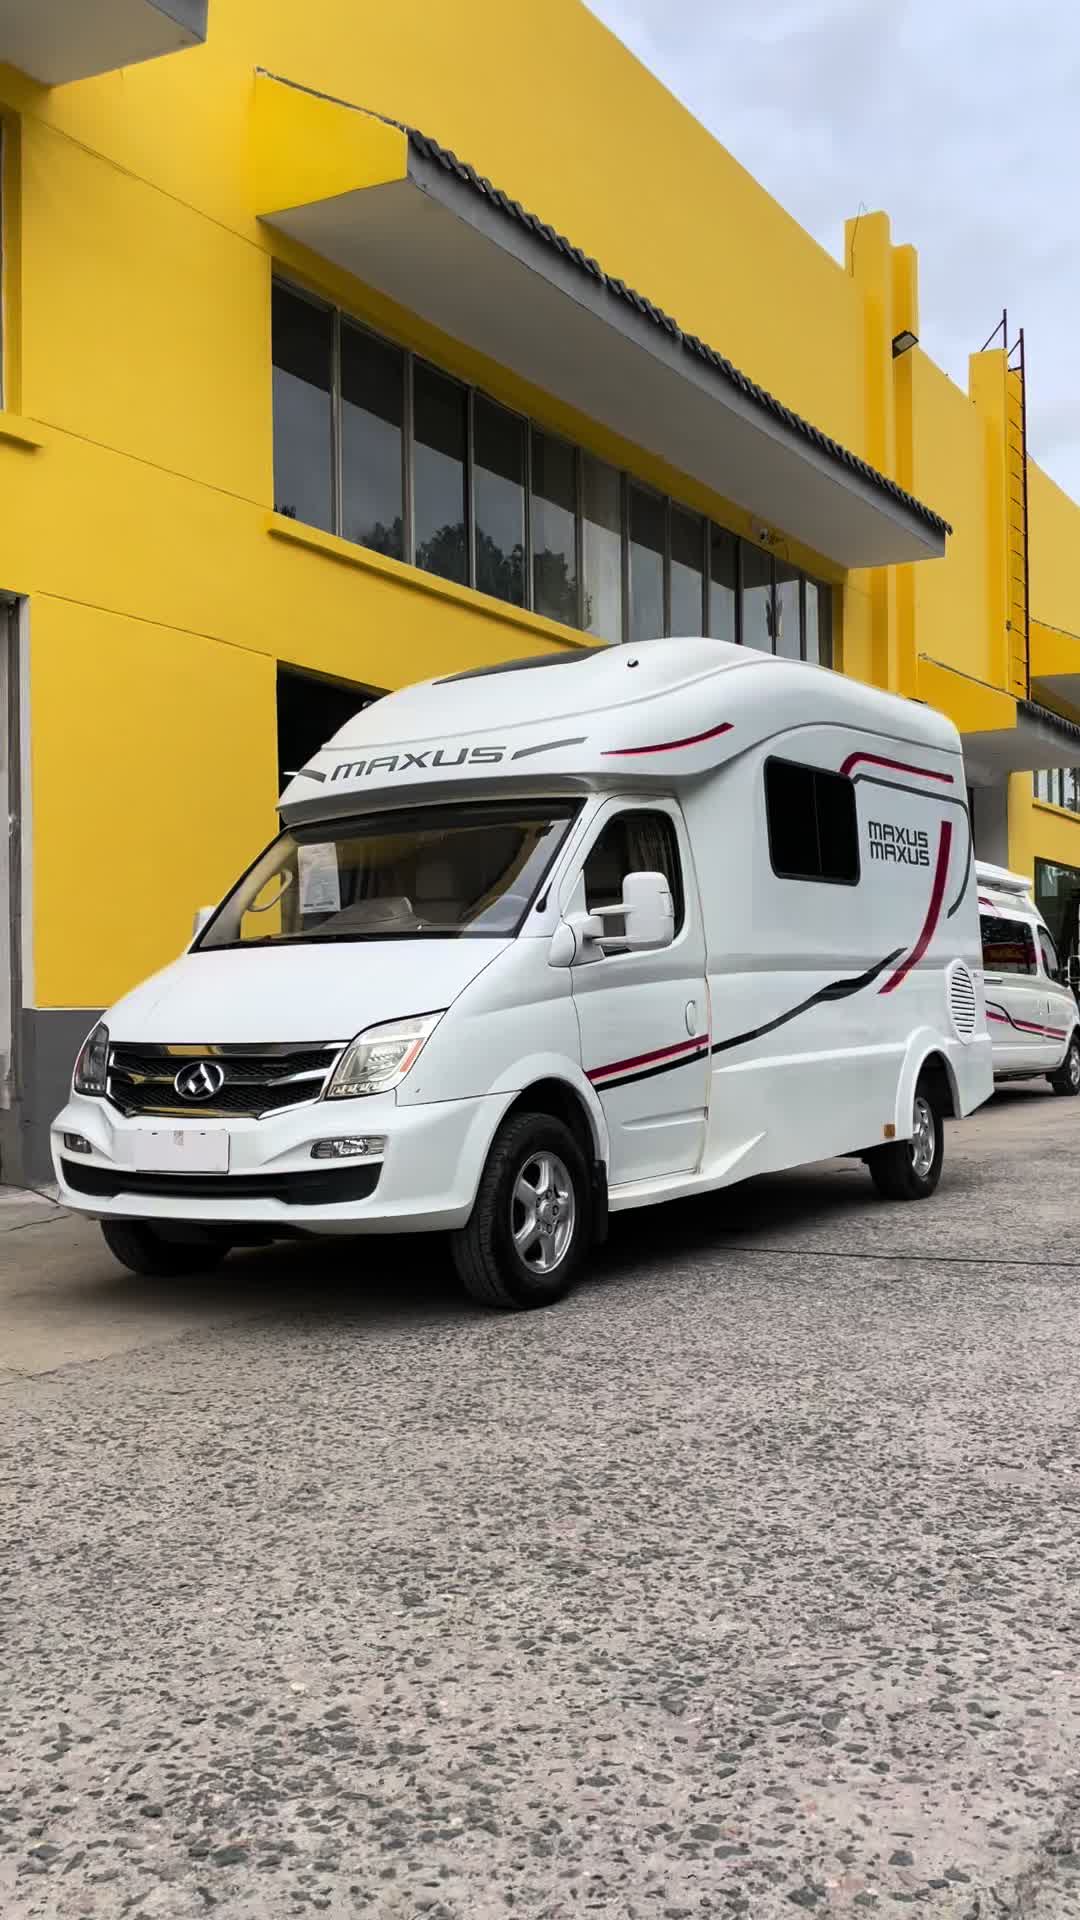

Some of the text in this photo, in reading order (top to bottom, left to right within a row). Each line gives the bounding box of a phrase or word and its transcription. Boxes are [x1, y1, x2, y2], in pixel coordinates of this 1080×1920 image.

[331, 746, 507, 782] MAXUS
[868, 821, 928, 848] MAXUS
[870, 841, 930, 866] MAXUS
